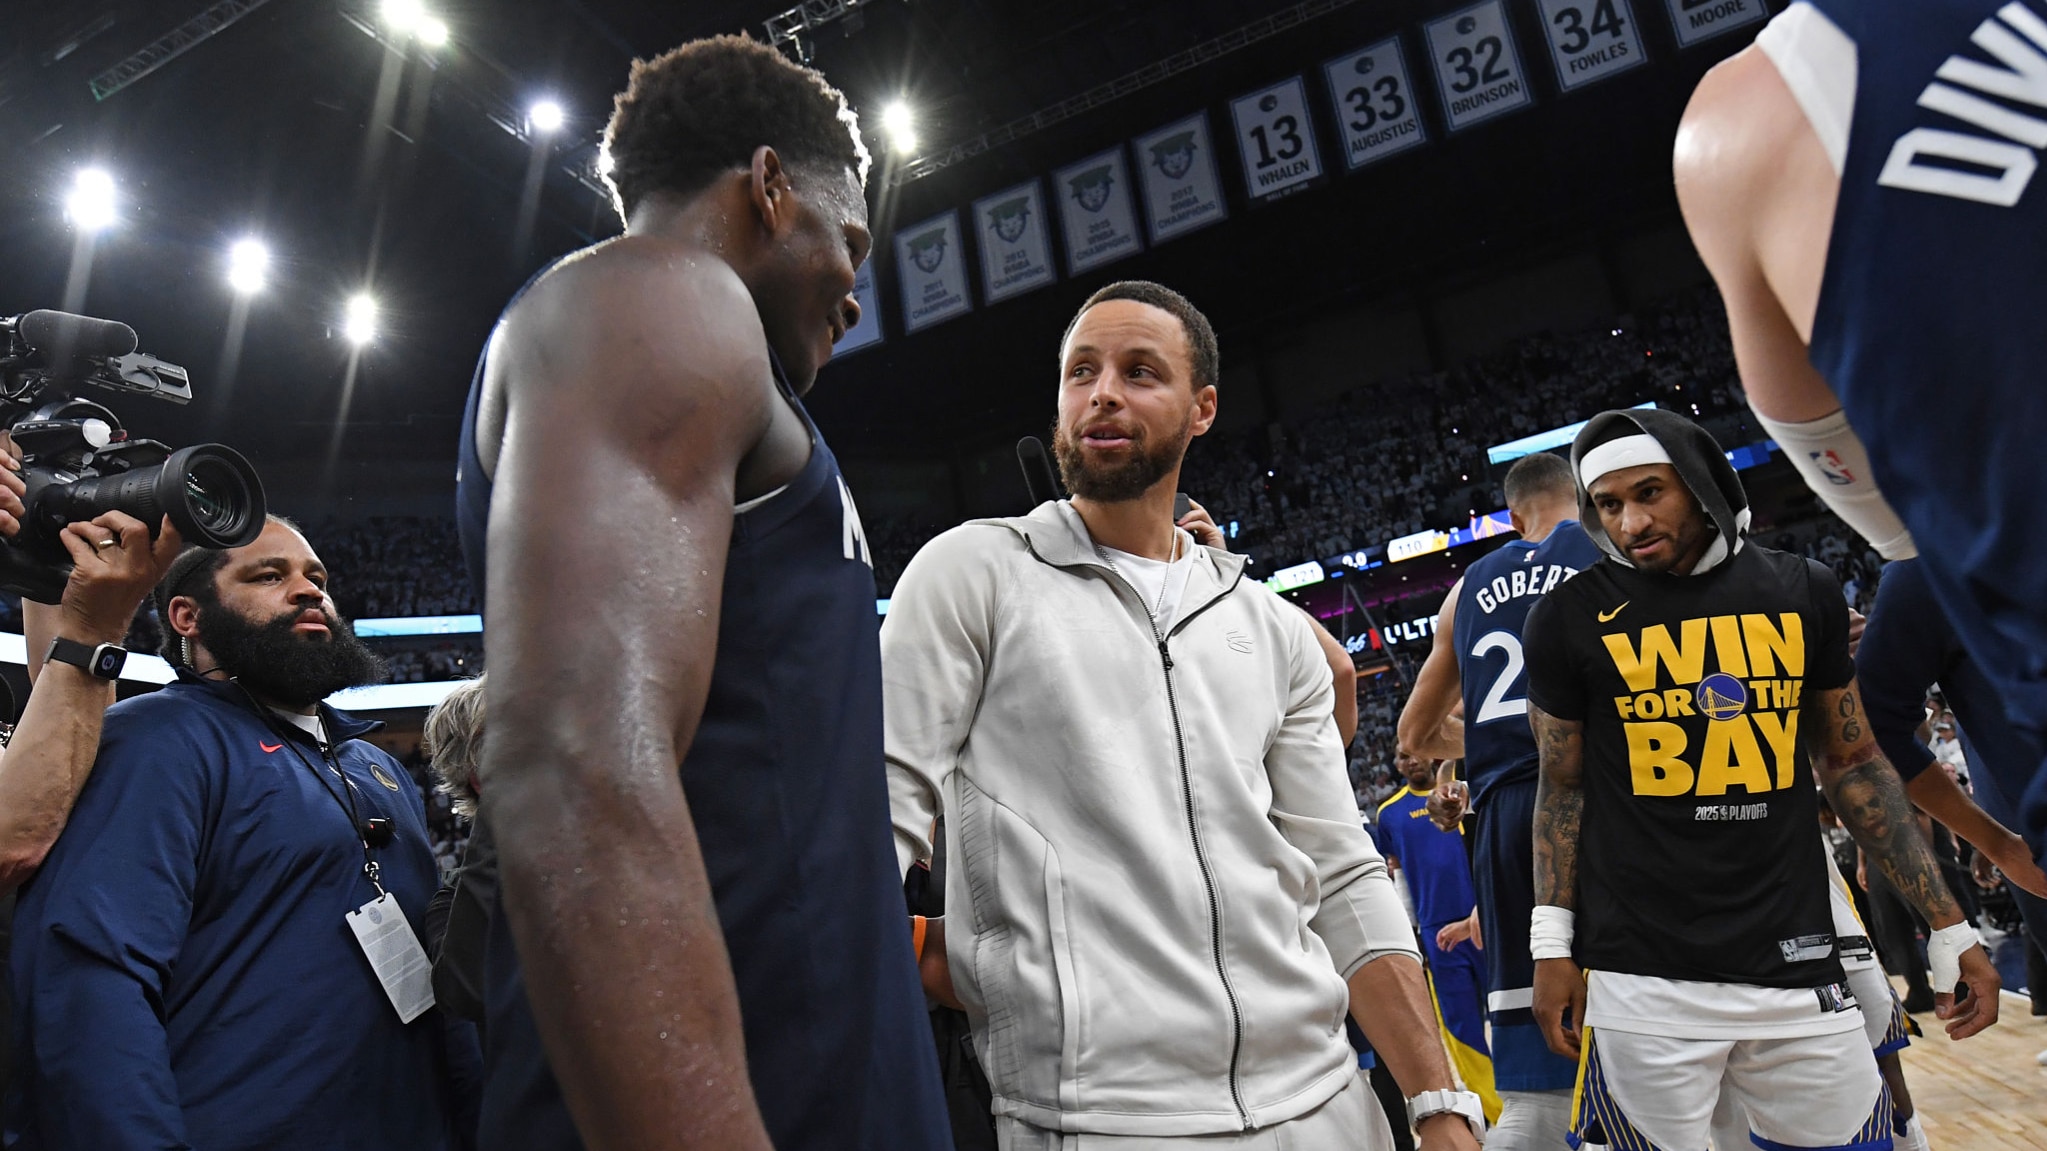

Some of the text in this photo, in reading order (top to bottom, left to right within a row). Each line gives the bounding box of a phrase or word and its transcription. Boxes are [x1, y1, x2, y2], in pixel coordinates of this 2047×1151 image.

[1554, 0, 1625, 55] 34
[1689, 1, 1746, 29] MOORE
[1446, 35, 1510, 93] 32
[1570, 42, 1628, 74] FOWLES
[1345, 75, 1405, 132] 33
[1451, 80, 1520, 115] BRUNSON
[1249, 115, 1303, 169] 13
[1351, 119, 1417, 154] AUGUSTUS
[1258, 159, 1310, 187] WHALEN
[1158, 201, 1216, 229] CHAMPIONS
[1076, 234, 1131, 260] CHAMPIONS
[993, 265, 1045, 289] CHAMPIONS
[1398, 540, 1423, 555] 110
[1293, 568, 1316, 584] 121
[1476, 564, 1580, 614] GOBERT
[1601, 612, 1805, 692] WIN
[1471, 631, 1528, 724] 2
[1614, 680, 1803, 720] FOR THE
[1623, 709, 1800, 796] BAY
[1695, 803, 1768, 820] 2025 PLAYOFFS
